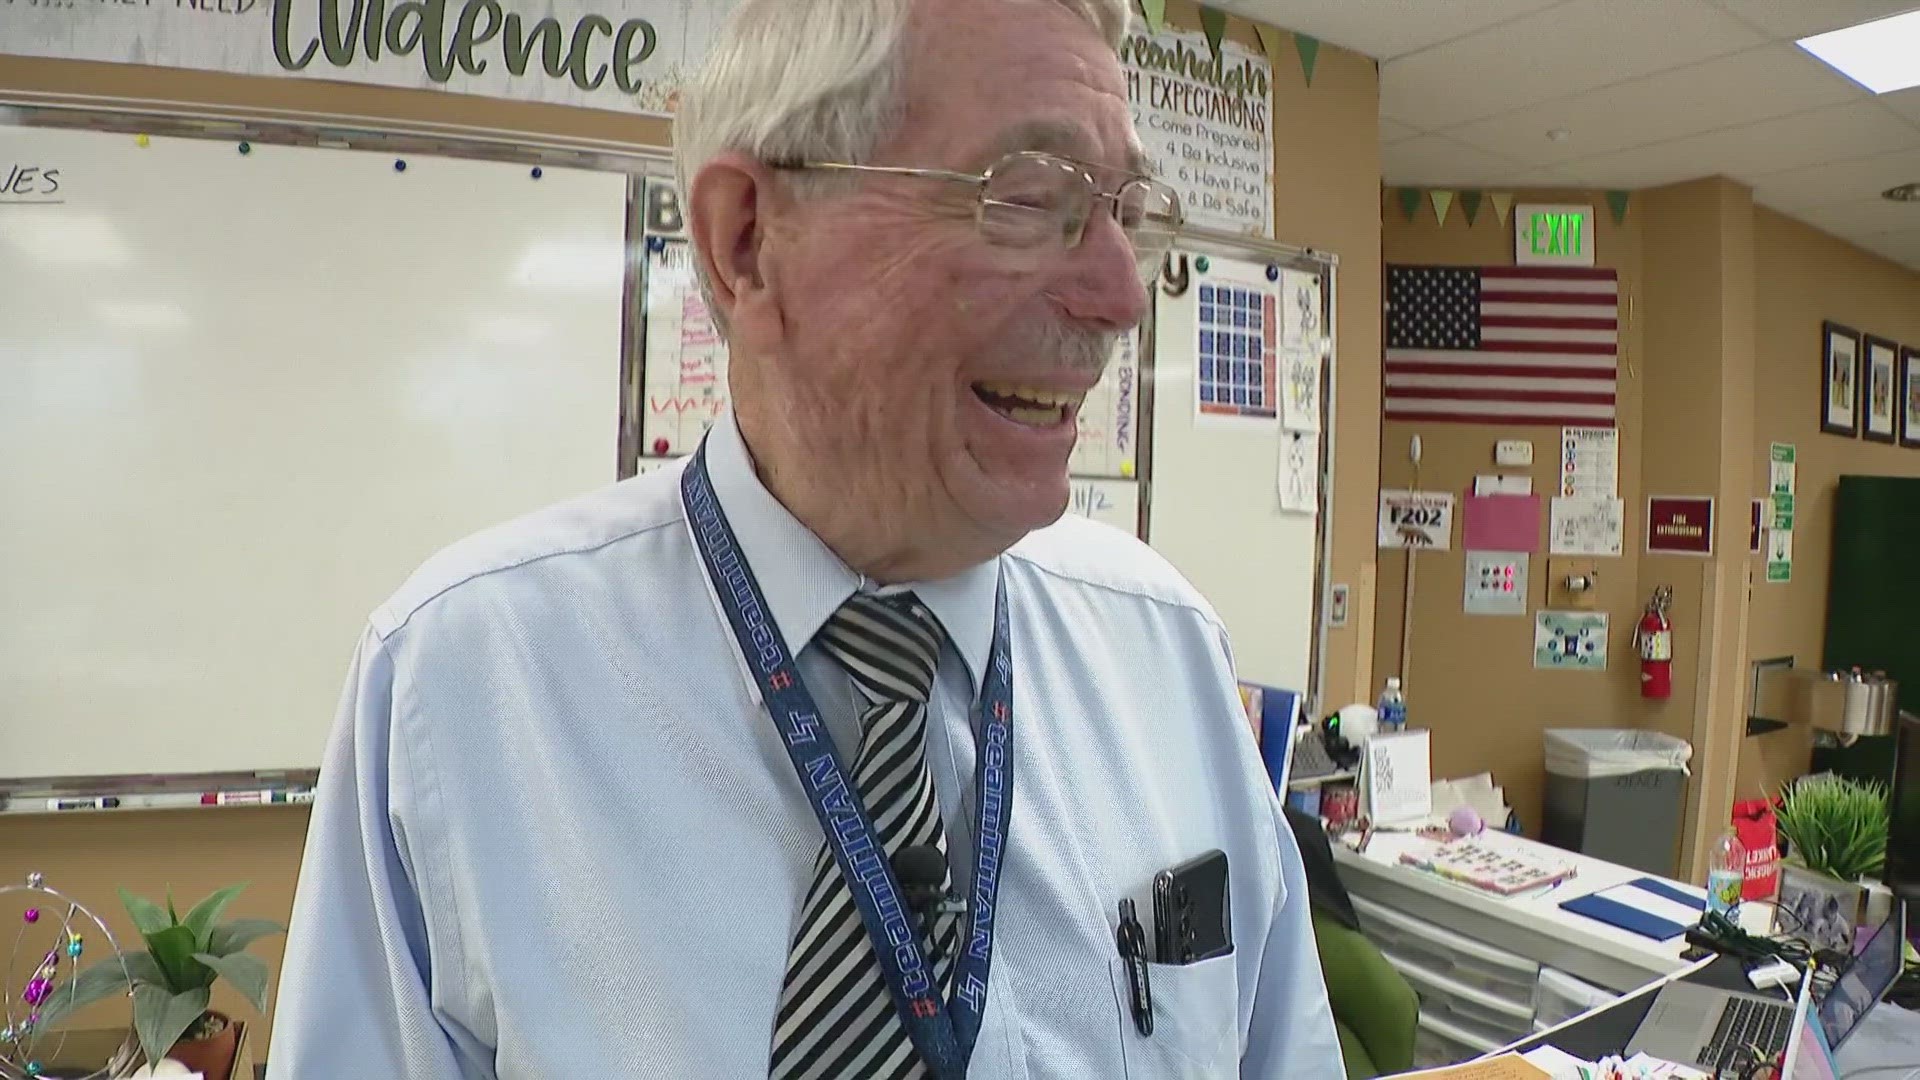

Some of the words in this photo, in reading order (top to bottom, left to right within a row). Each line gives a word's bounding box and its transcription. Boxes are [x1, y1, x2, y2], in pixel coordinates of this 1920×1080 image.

[1150, 74, 1266, 133] EXPECTATIONS
[1148, 113, 1192, 136] Come
[1196, 123, 1260, 152] Prepared
[1182, 142, 1202, 161] Be
[1205, 147, 1260, 175] Inclusive
[1194, 166, 1231, 190] Have
[1233, 176, 1260, 197] Fun
[1202, 191, 1222, 211] Be
[1225, 196, 1260, 219] Safe
[1530, 212, 1584, 256] EXIT
[1116, 366, 1133, 455] BONDING
